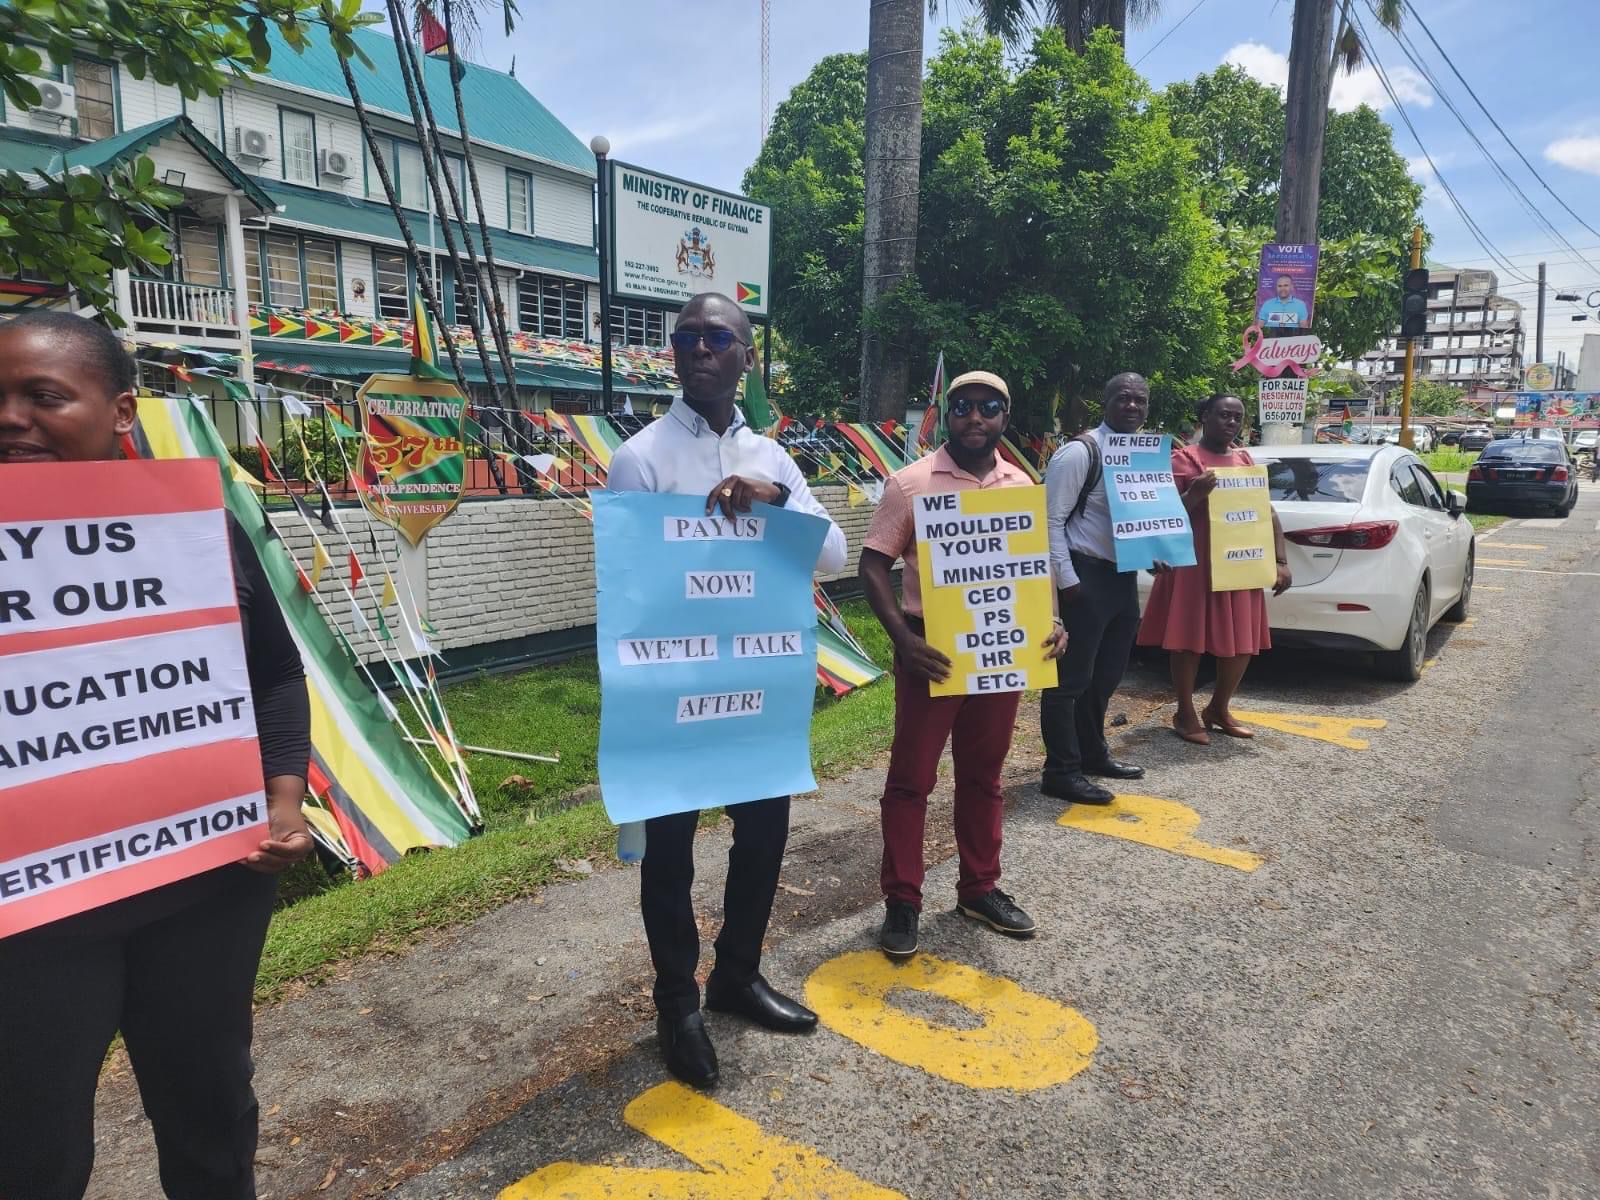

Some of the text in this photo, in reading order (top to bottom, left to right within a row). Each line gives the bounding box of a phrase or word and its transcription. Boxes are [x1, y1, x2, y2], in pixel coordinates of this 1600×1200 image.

[623, 173, 763, 224] MINISTRY OF FINANCE
[637, 200, 749, 234] THE COOPERATIVE REPUBLIC OF GUYANA
[1278, 245, 1304, 253] VOTE
[1258, 339, 1319, 362] always
[1262, 380, 1305, 391] FOR SALE
[1260, 391, 1305, 401] RESIDENTIAL
[367, 399, 460, 418] CELEBRATING
[1262, 401, 1303, 411] HOUSE LOTS
[1109, 436, 1161, 447] WE NEED
[1105, 454, 1130, 465] OUR
[1116, 473, 1173, 484] SALARIES
[923, 494, 957, 511] WE
[1120, 490, 1157, 501] TO BE
[676, 518, 758, 538] PAY US
[926, 515, 1032, 539] MOULDED
[1116, 518, 1184, 534] ADJUSTED
[0, 522, 136, 561] Y US
[940, 537, 1002, 557] YOUR
[1227, 548, 1263, 559] DONE!
[943, 559, 1047, 584] MINISTER
[689, 575, 752, 595] NOW!
[53, 577, 167, 617] OUR
[968, 586, 1011, 605] CEO
[984, 609, 1011, 626] PS
[736, 635, 796, 654] TALK
[966, 629, 1025, 648] DCEO
[982, 650, 1013, 668] HR
[0, 657, 210, 717] UCATION
[977, 673, 1026, 690] ETC.
[680, 691, 762, 718] AFTER!
[0, 802, 258, 898] ERTIFICATION
